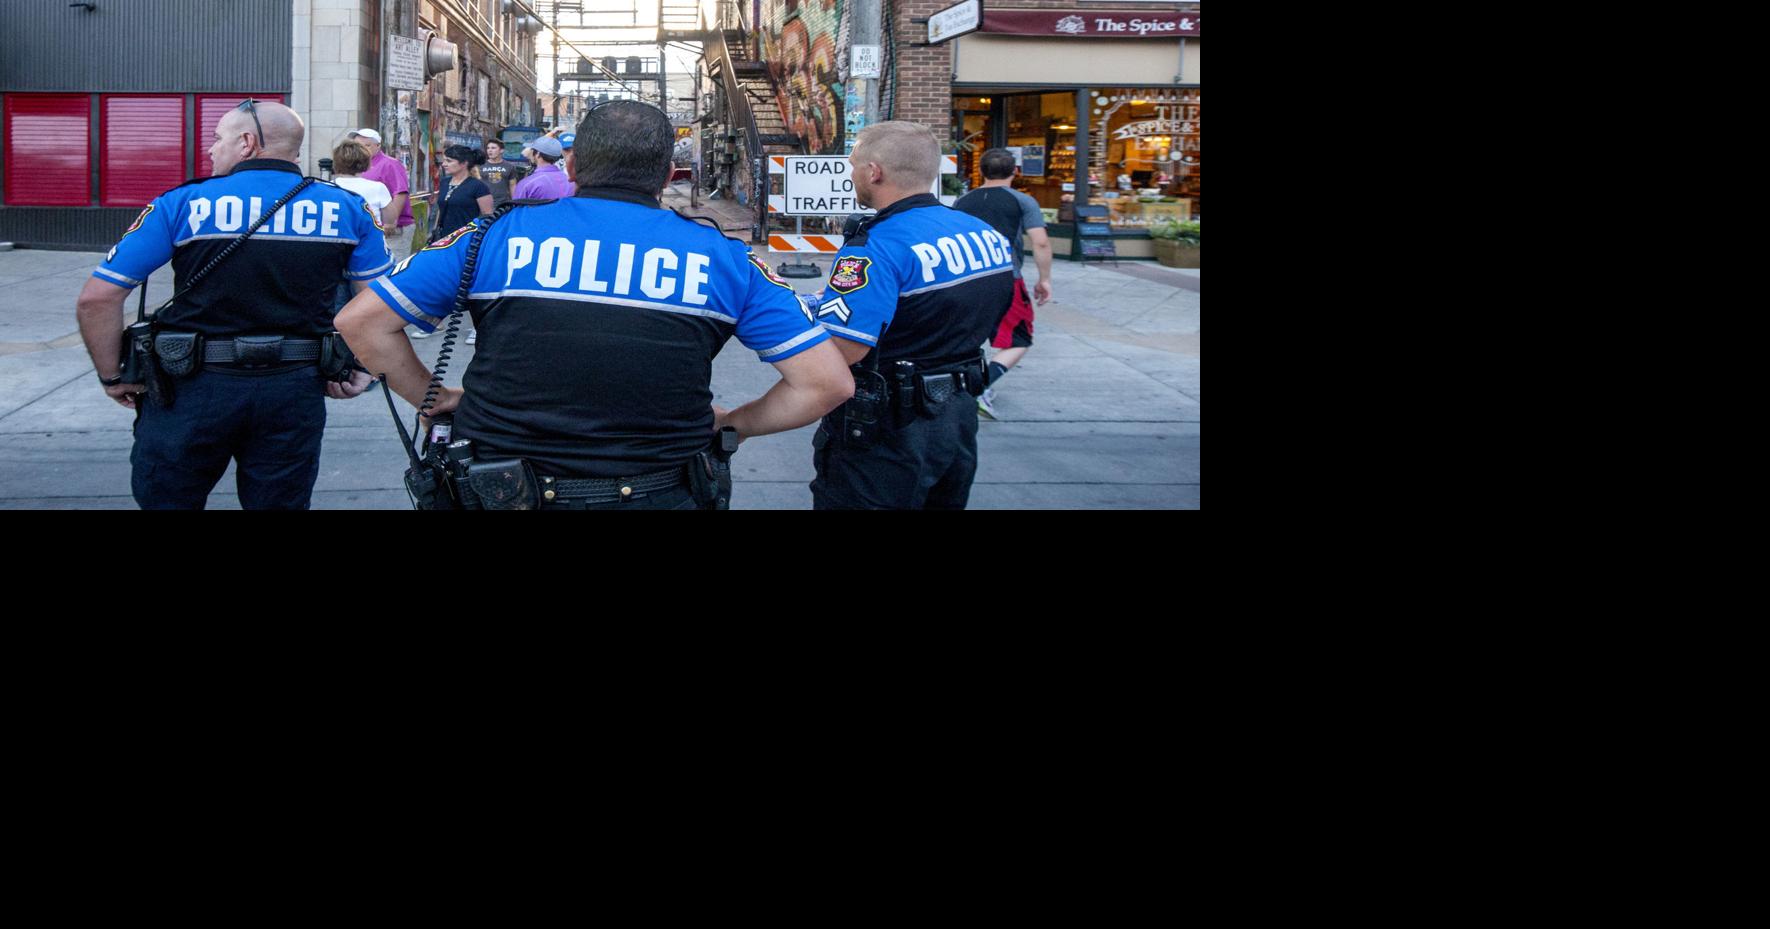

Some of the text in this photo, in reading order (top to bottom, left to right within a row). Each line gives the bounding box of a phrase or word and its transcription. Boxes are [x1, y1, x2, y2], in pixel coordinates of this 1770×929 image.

[1095, 18, 1127, 32] The
[1129, 18, 1176, 35] Spice
[1179, 17, 1195, 31] &
[795, 161, 845, 175] ROAD
[188, 195, 340, 237] POLICE
[505, 236, 710, 306] POLICE
[910, 229, 1012, 283] POLICE
